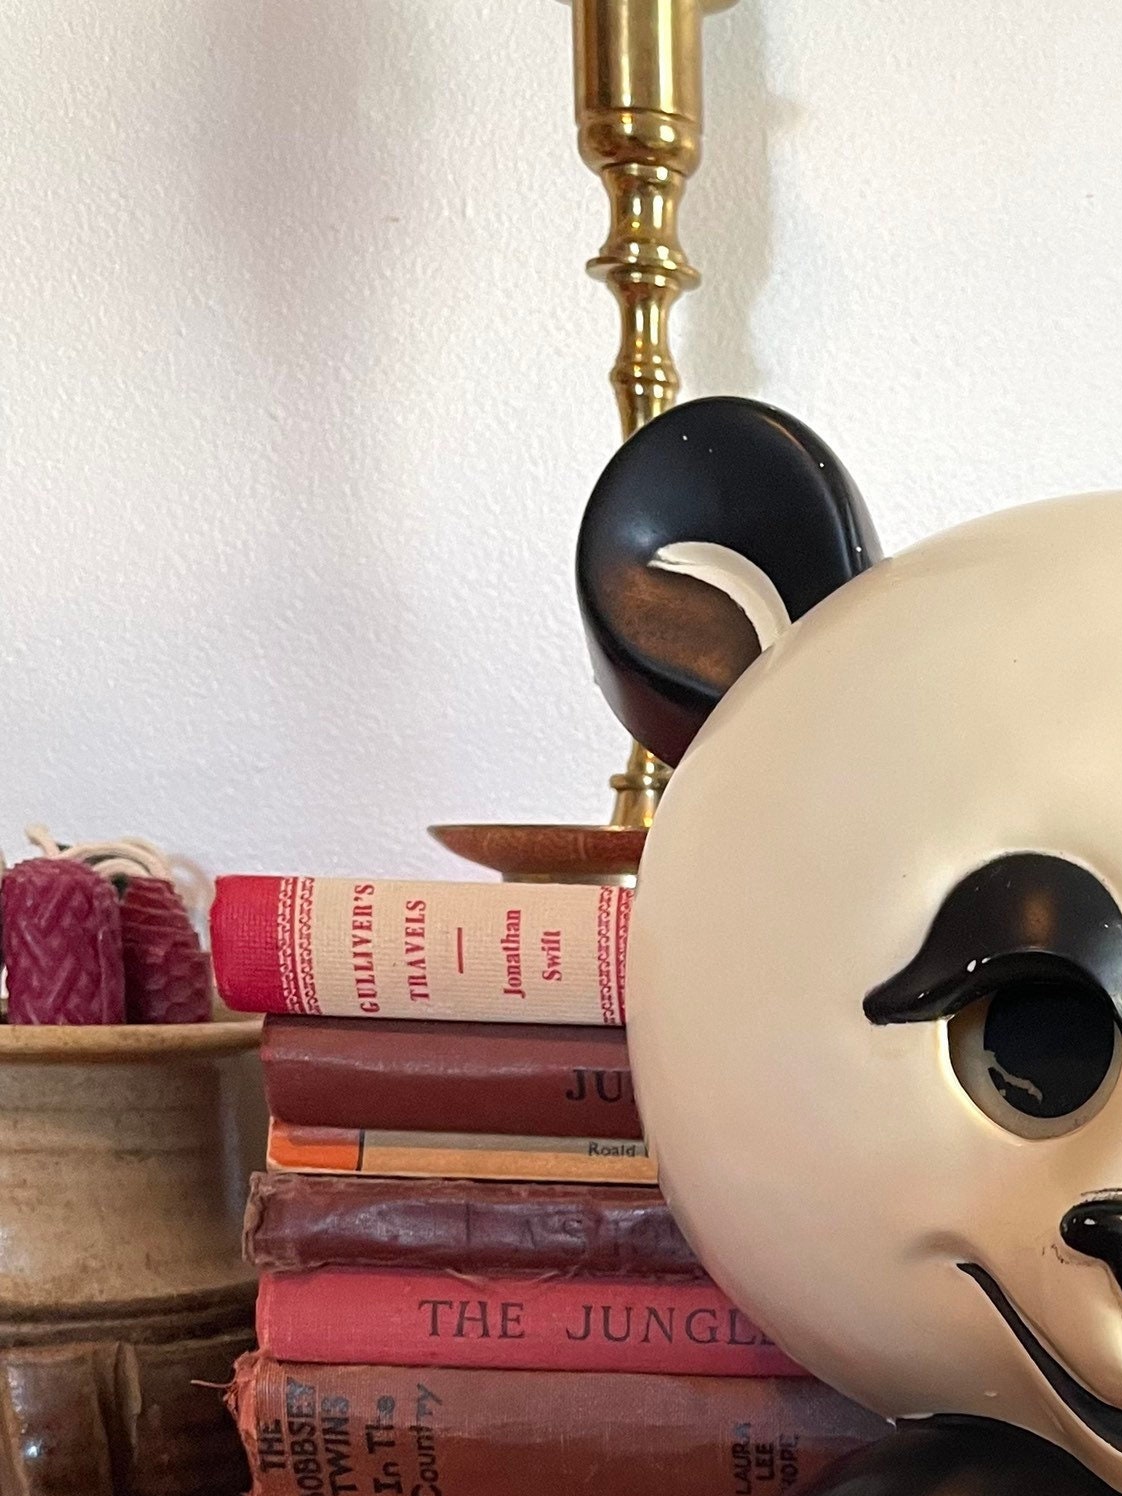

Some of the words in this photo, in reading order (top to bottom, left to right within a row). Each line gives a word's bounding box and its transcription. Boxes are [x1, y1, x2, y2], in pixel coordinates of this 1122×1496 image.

[354, 883, 380, 1014] GULLIVER'S
[405, 900, 431, 1002] TRAVELS
[503, 909, 526, 999] Jonathan
[541, 930, 562, 982] Swift
[565, 1070, 634, 1104] JU
[588, 1141, 636, 1157] Roald
[418, 1300, 525, 1339] THE
[259, 1418, 286, 1473] THE
[320, 1396, 358, 1496] TWINS
[732, 1423, 752, 1495] LAURA
[755, 1443, 775, 1480] LEE
[373, 1461, 403, 1495] In
